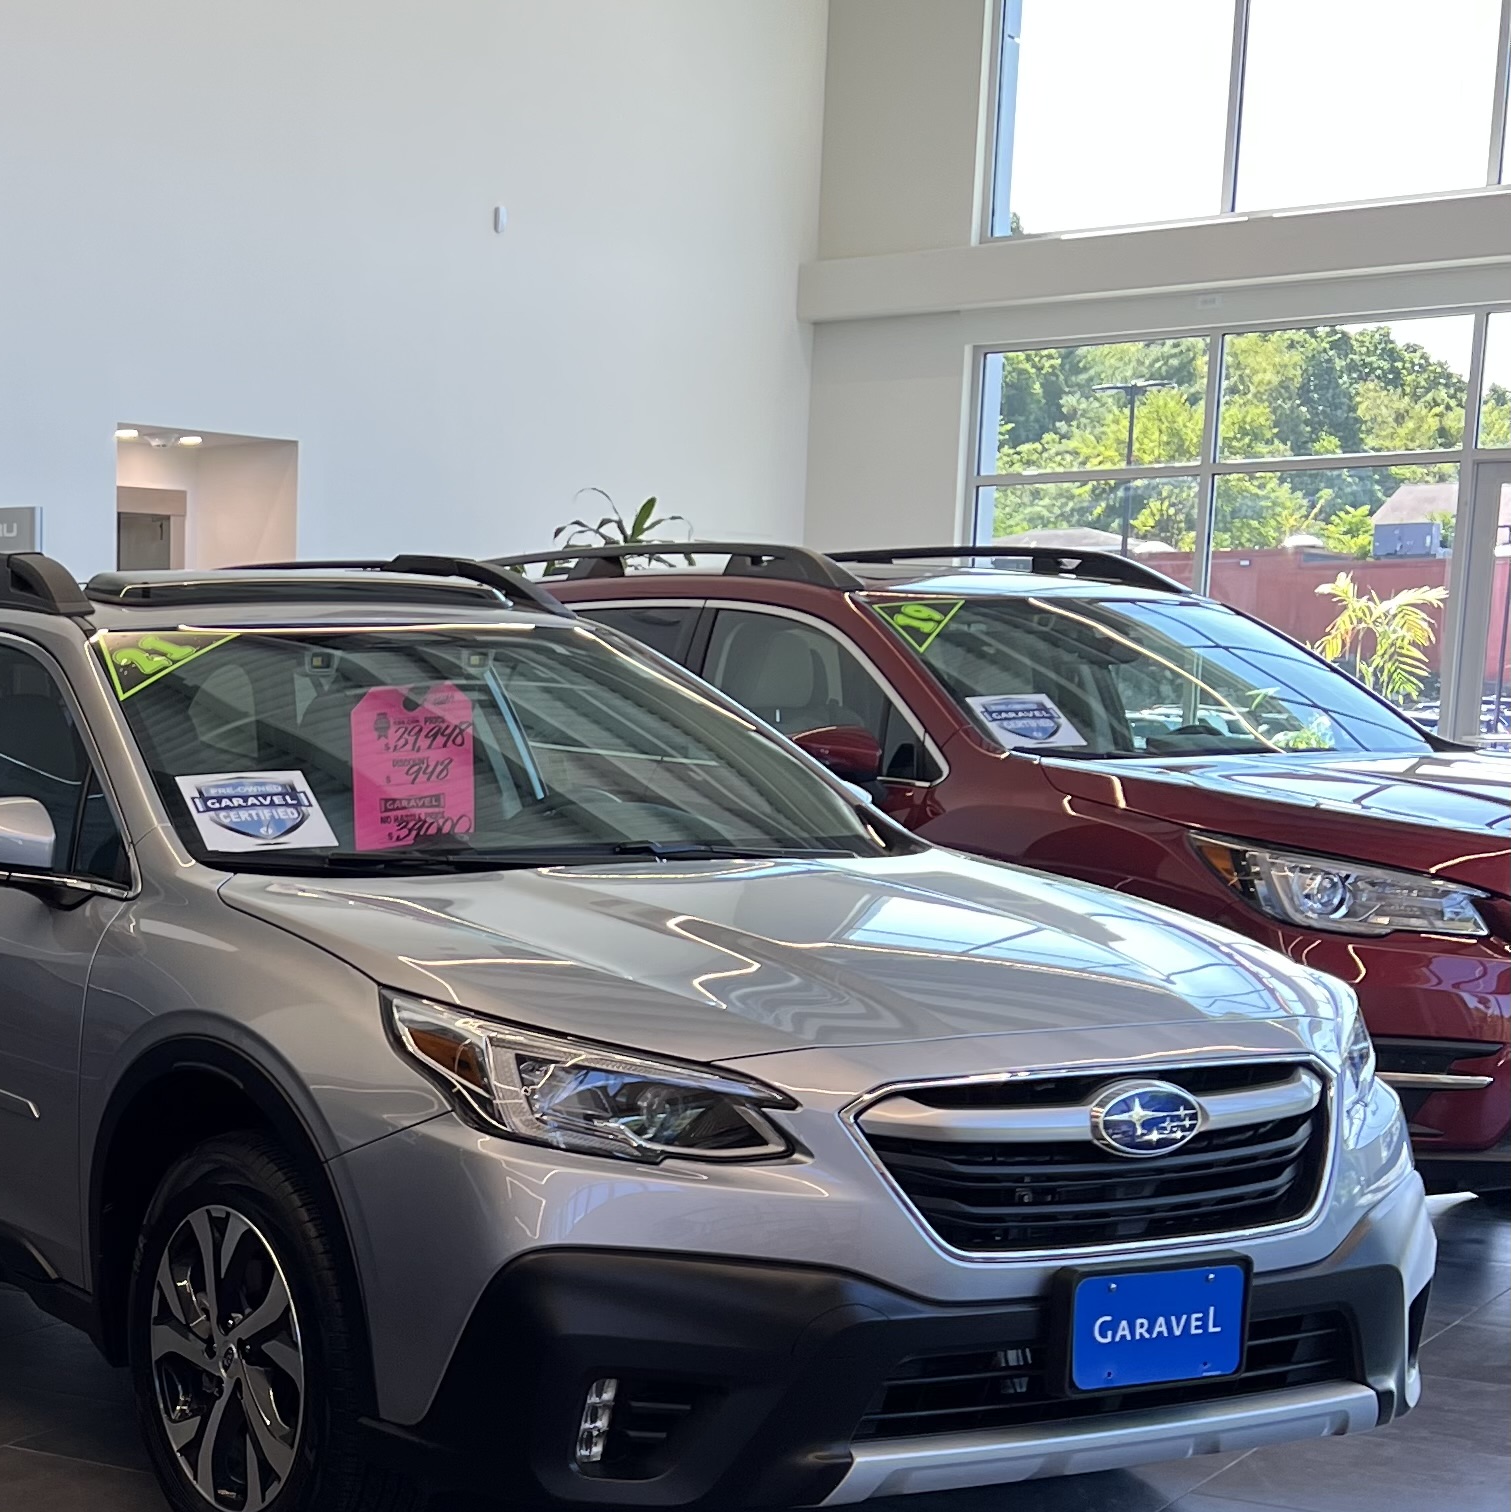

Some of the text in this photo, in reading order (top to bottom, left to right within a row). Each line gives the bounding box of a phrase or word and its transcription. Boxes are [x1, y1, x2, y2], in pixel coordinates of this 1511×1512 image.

[991, 710, 1052, 719] GARAVEL
[206, 795, 298, 809] GARAVEL
[386, 797, 440, 810] GARAVEL
[219, 808, 299, 823] CERTIFIED
[1094, 1306, 1222, 1344] GARAVEL
